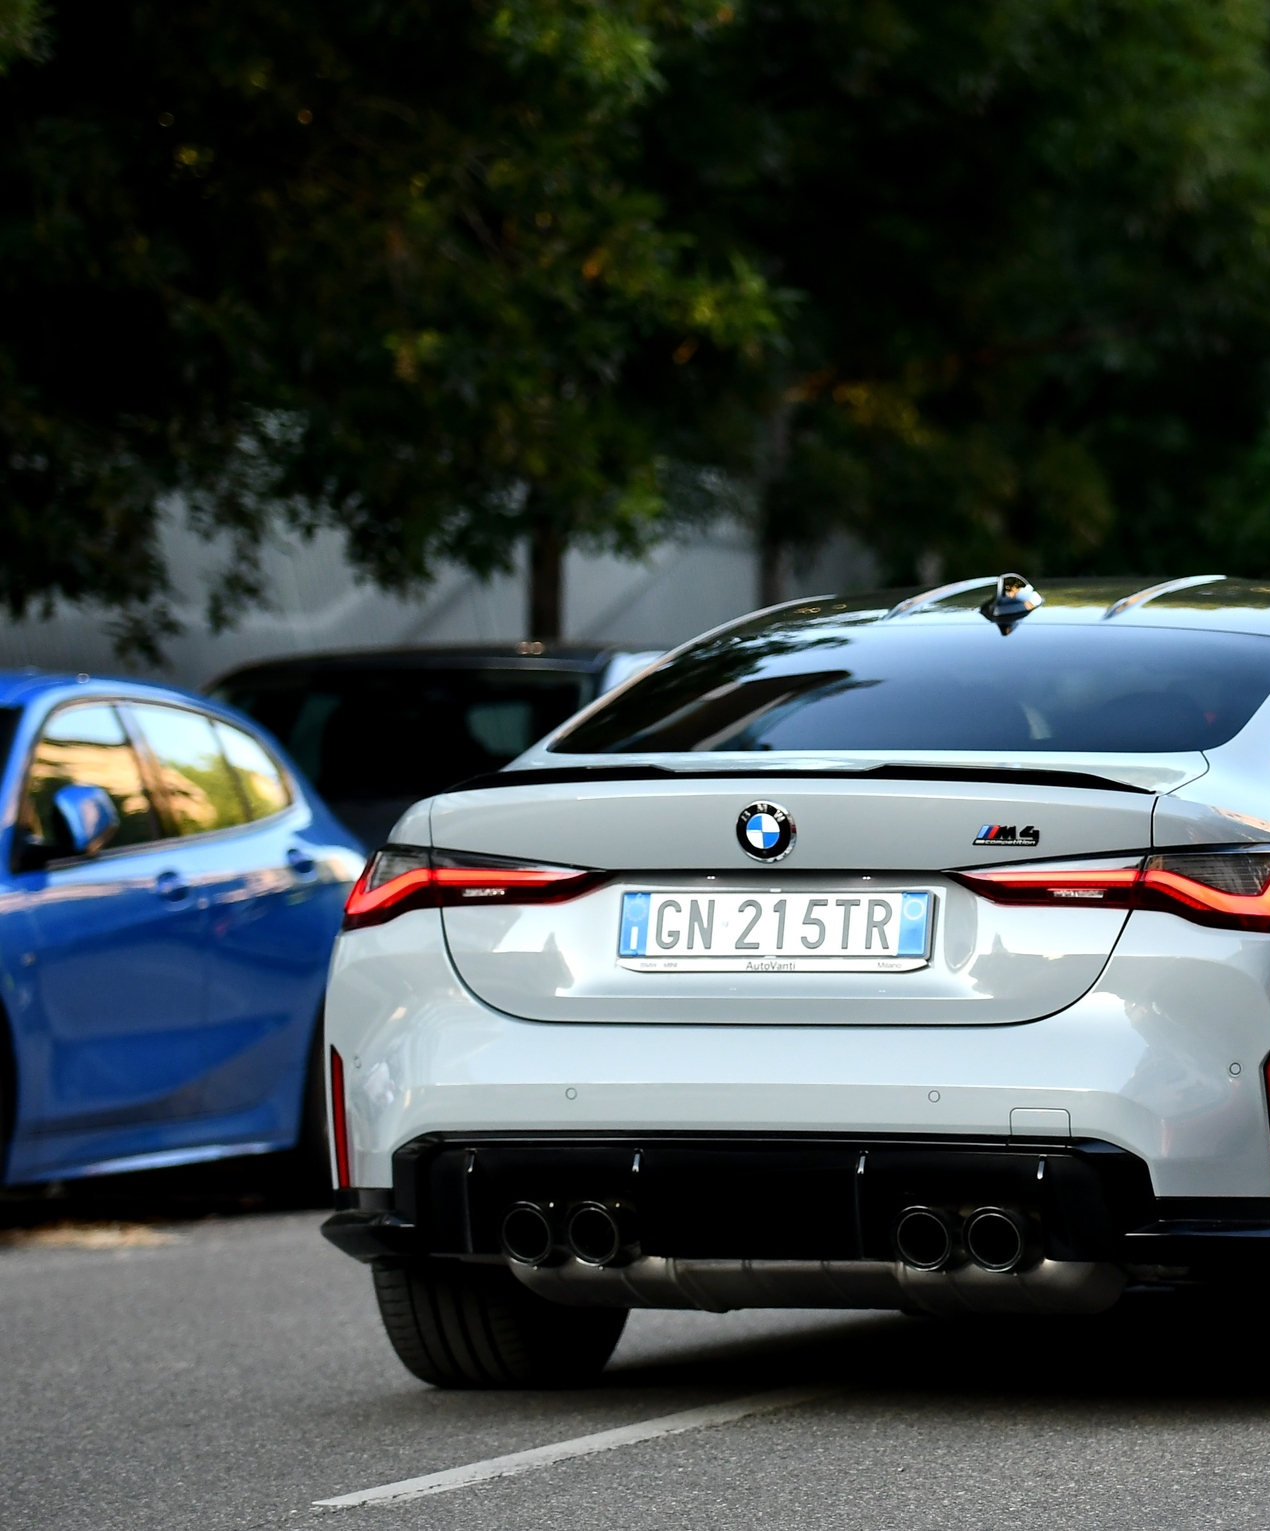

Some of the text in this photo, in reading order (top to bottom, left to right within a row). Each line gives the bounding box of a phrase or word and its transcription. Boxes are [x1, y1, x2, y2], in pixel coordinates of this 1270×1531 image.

[741, 804, 786, 822] BMW
[990, 825, 1040, 840] M4
[655, 899, 893, 950] GN 215TR
[745, 961, 796, 970] AutoVanti
